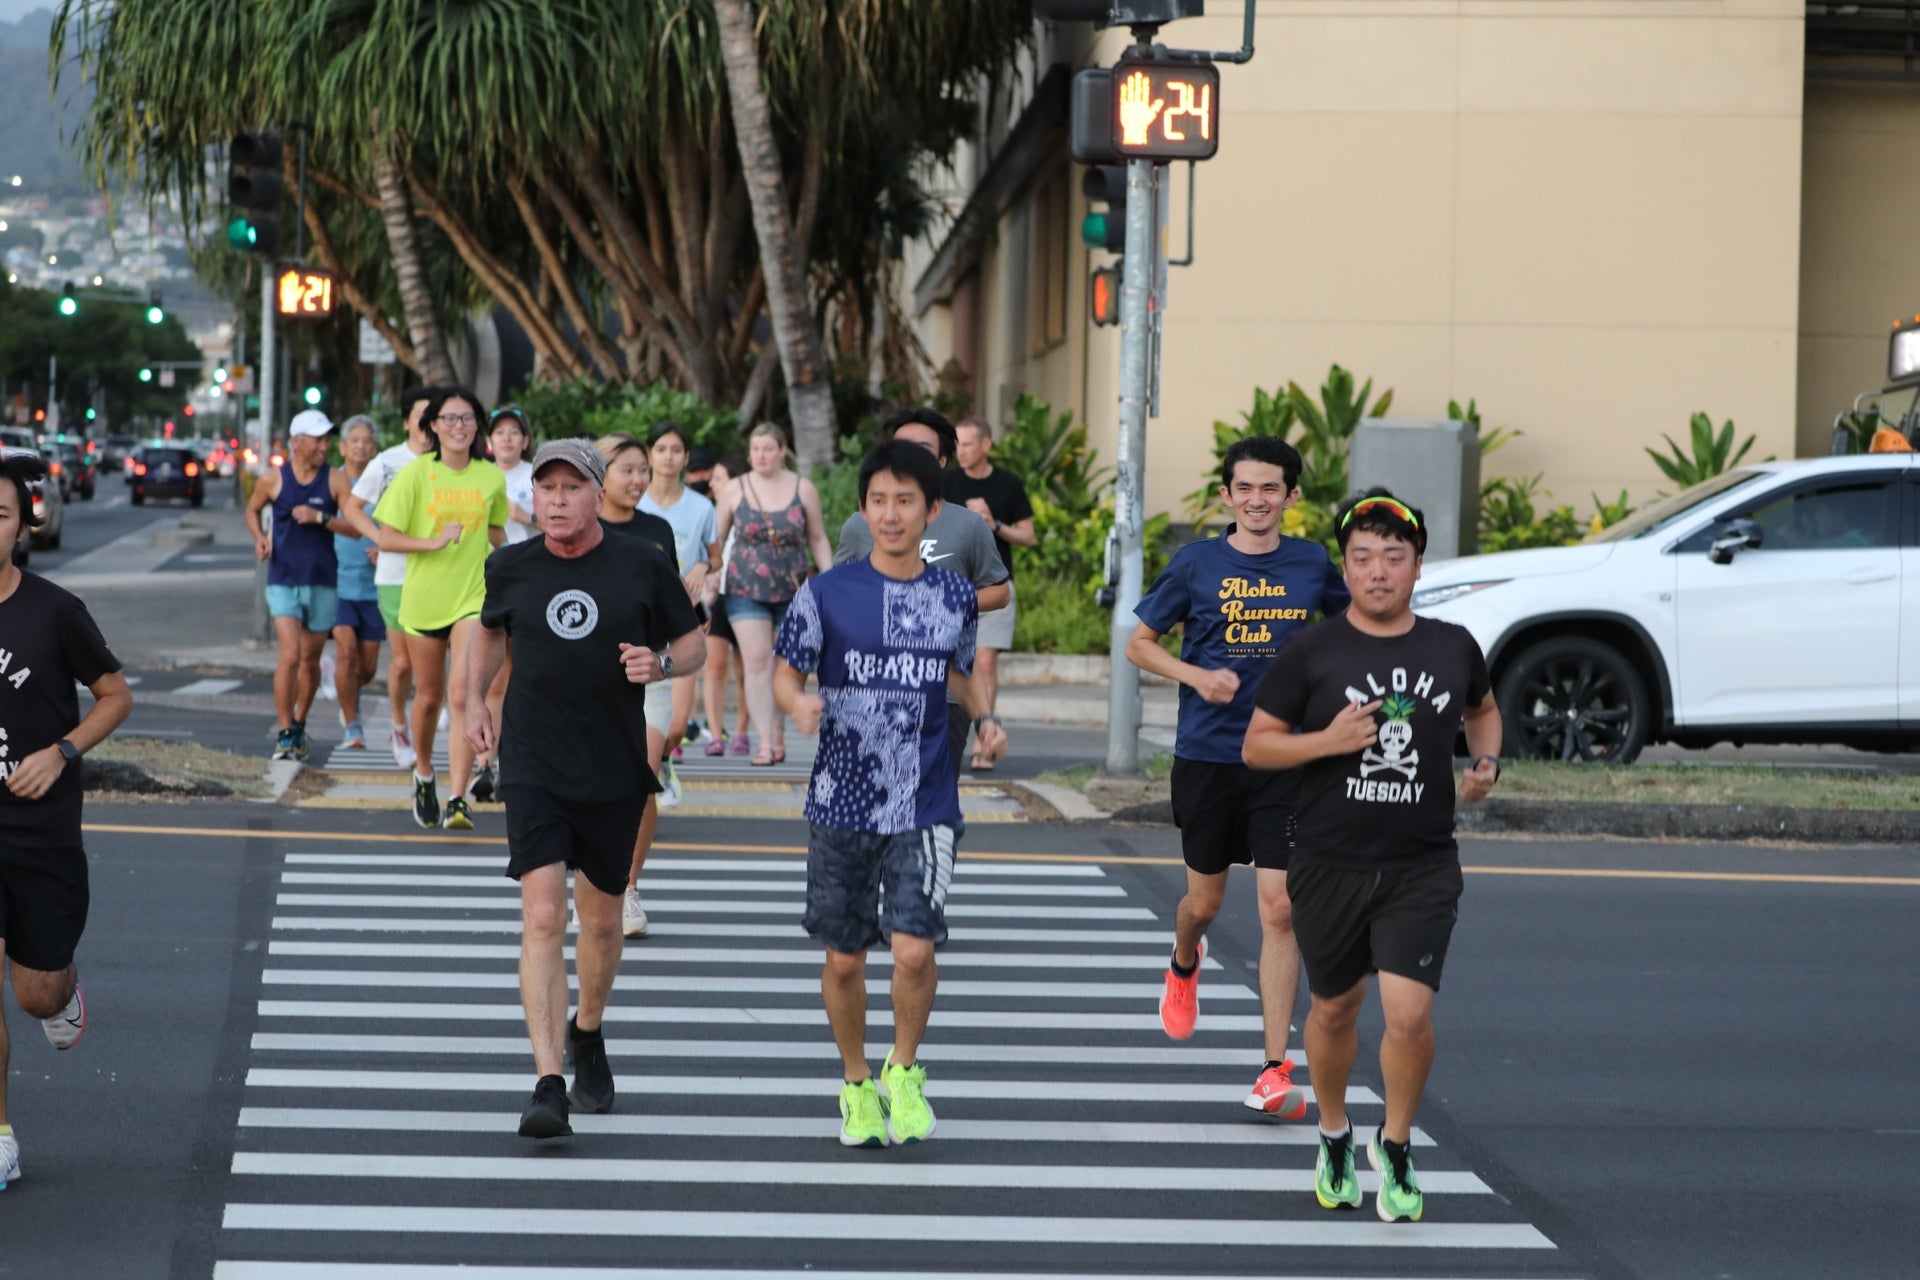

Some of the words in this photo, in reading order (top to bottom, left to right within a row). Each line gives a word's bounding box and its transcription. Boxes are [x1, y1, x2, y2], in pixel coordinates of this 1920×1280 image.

[1164, 81, 1210, 141] 24
[302, 275, 331, 312] 21
[434, 487, 486, 508] KOKUA
[1218, 577, 1287, 599] Aloha
[1221, 600, 1307, 622] Runners
[1225, 622, 1272, 644] Club
[1345, 667, 1451, 714] ALOHA
[1346, 776, 1424, 804] TUESDAY
